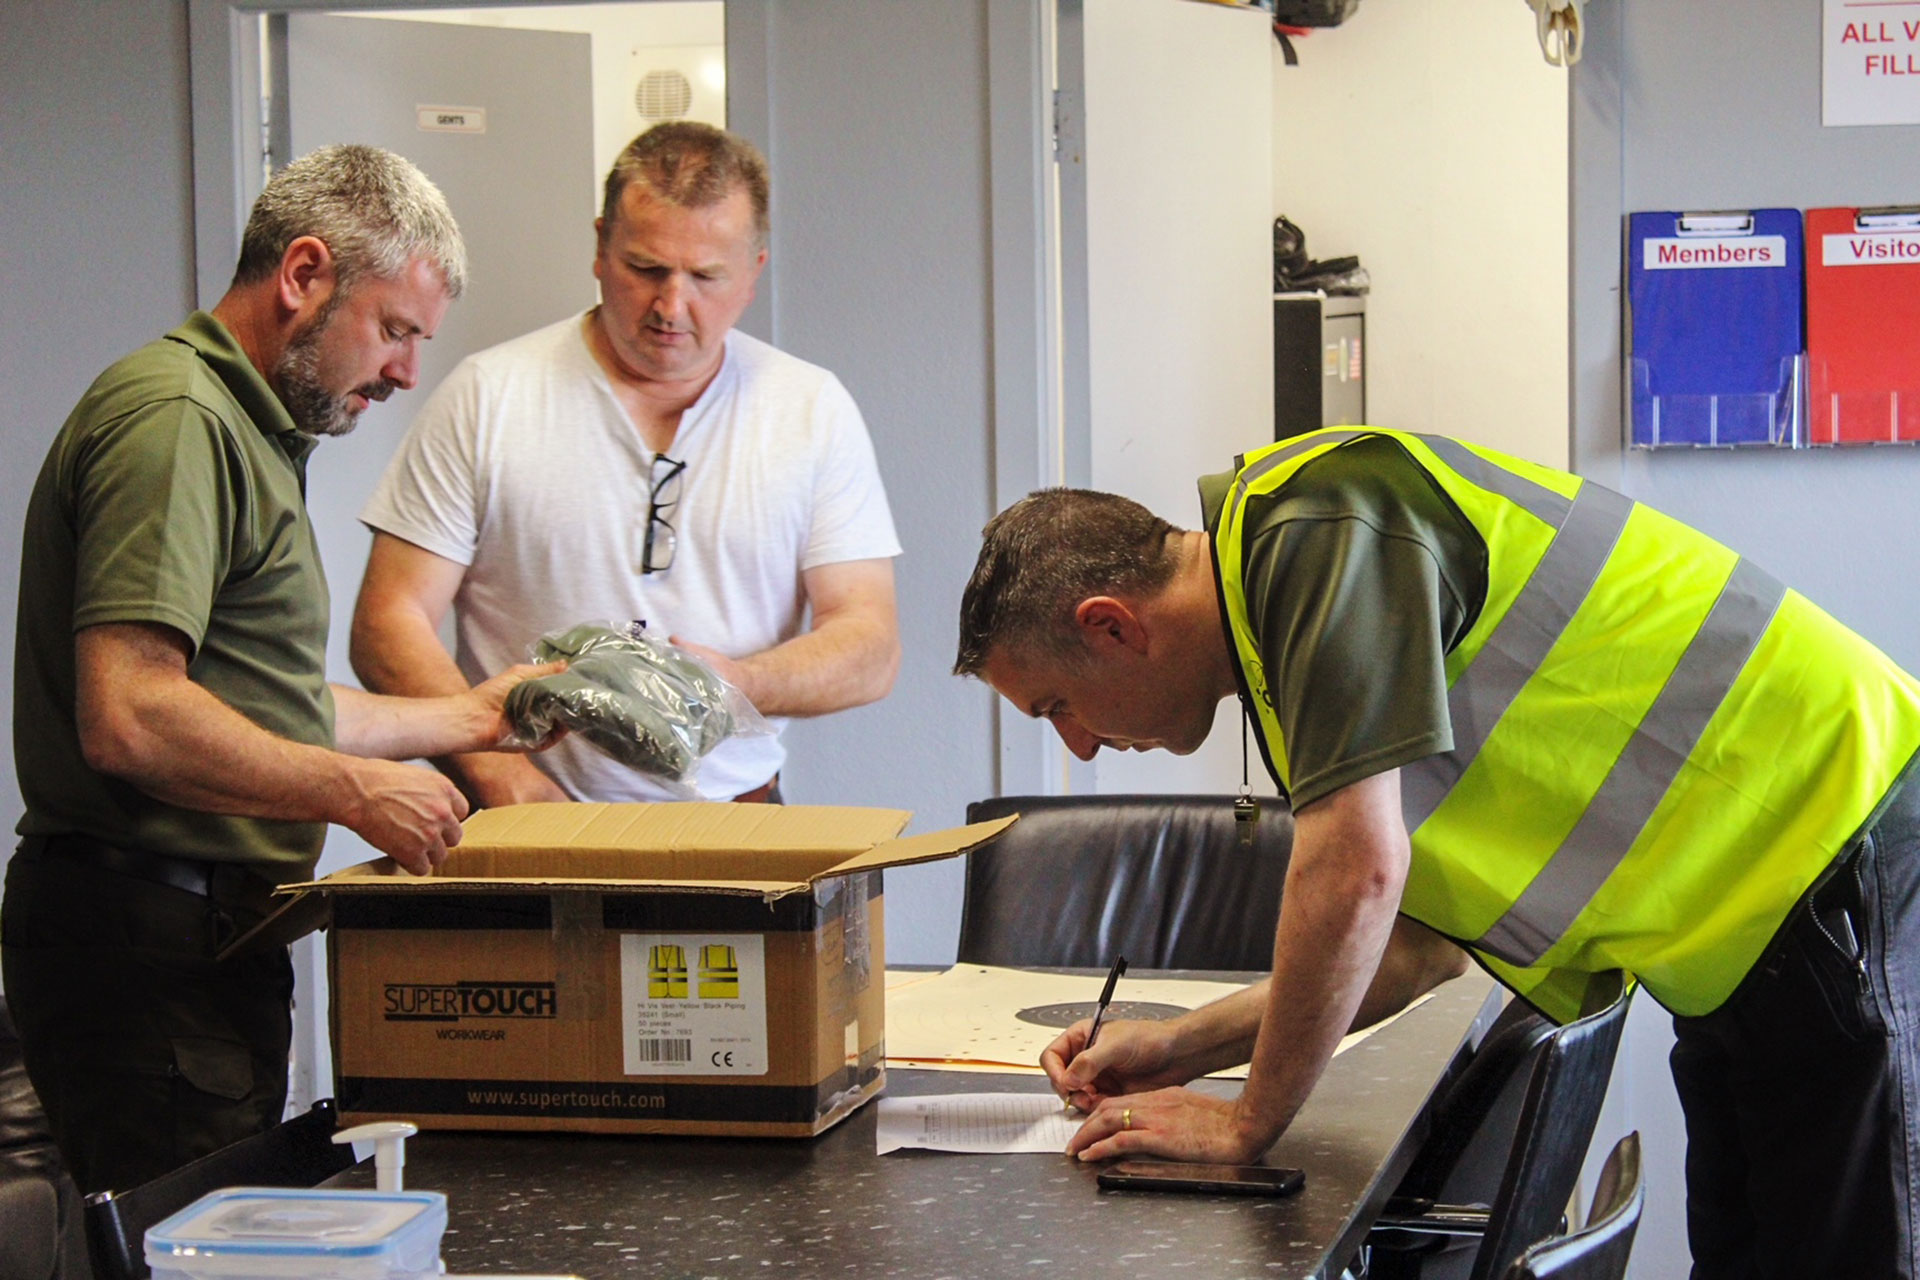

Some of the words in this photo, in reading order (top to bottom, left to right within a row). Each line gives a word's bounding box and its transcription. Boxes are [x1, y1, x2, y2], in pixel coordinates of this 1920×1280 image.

[1841, 22, 1894, 43] ALL
[1865, 54, 1920, 76] FILL
[437, 115, 465, 125] GENTS
[1658, 244, 1771, 264] Members
[1850, 238, 1920, 259] Visito
[384, 987, 557, 1015] SUPERTOUCH
[436, 1029, 506, 1041] WORKWEAR
[467, 1089, 666, 1109] www.supertouch.com
